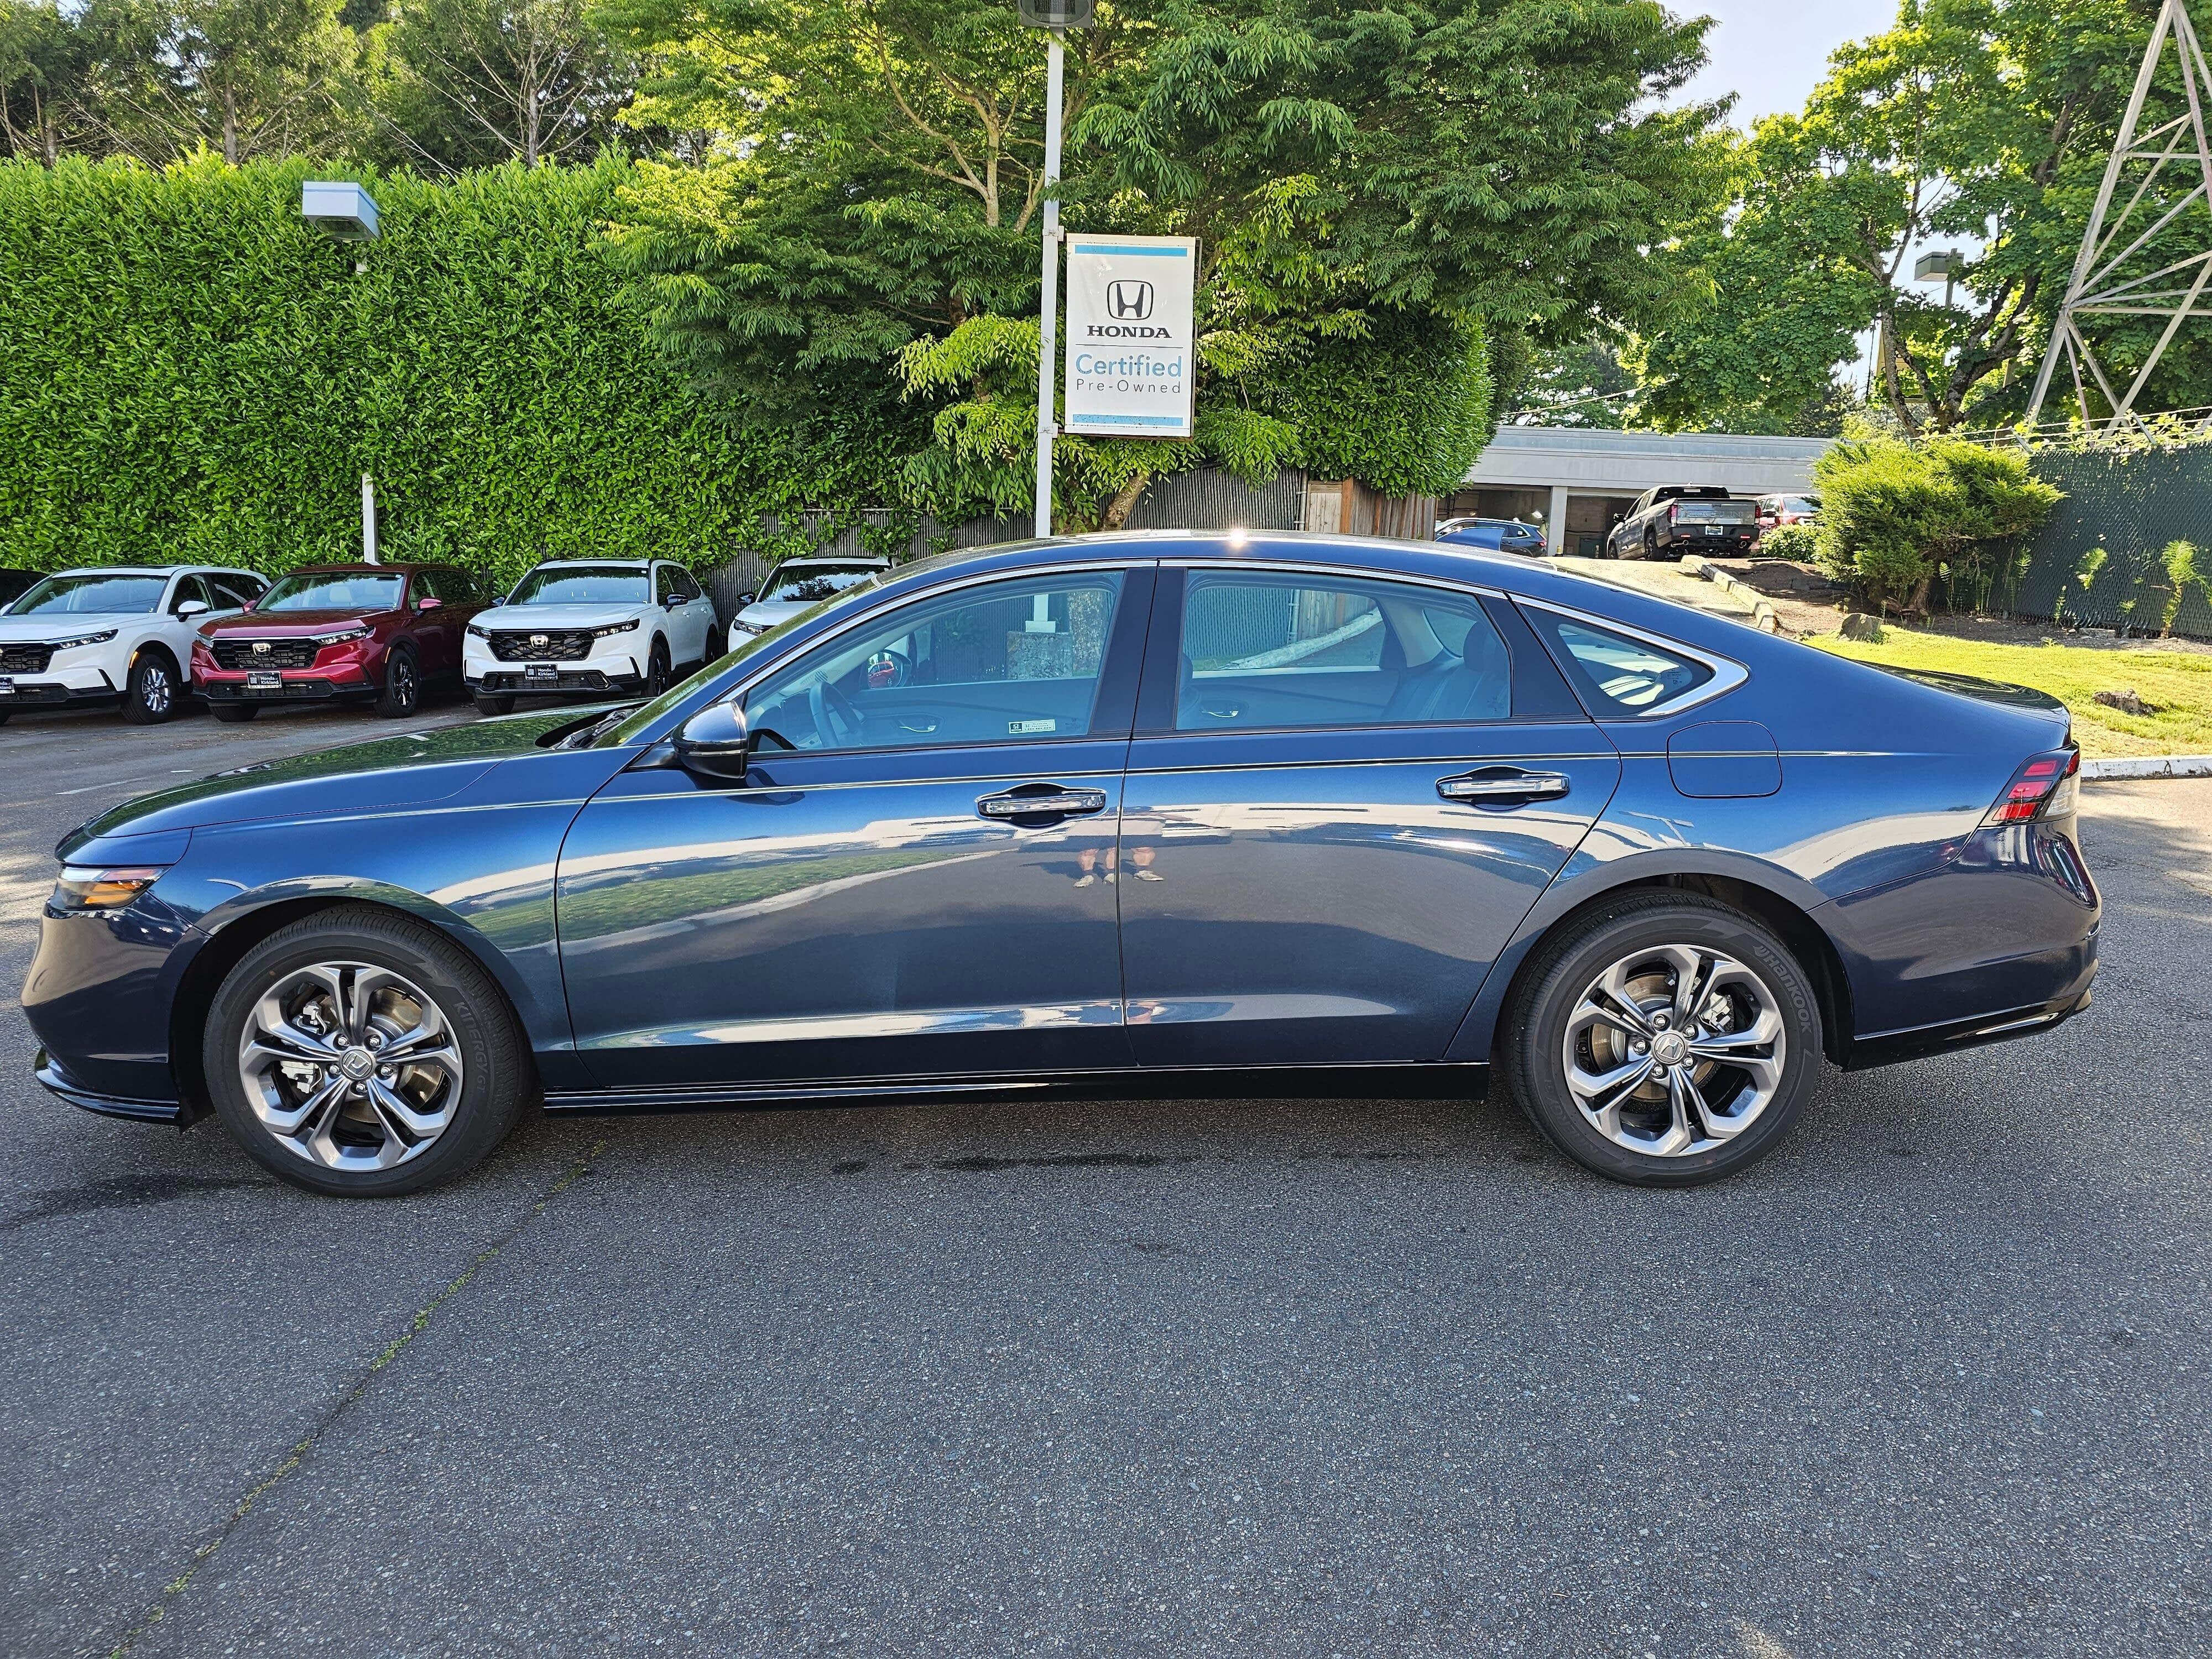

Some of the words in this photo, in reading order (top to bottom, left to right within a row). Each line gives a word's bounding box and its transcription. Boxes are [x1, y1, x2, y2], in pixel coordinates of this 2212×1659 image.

[1087, 325, 1172, 338] HONDA
[1076, 354, 1182, 377] Certified
[1077, 378, 1181, 394] Pre-Owned
[453, 1001, 488, 1073] KINERGY
